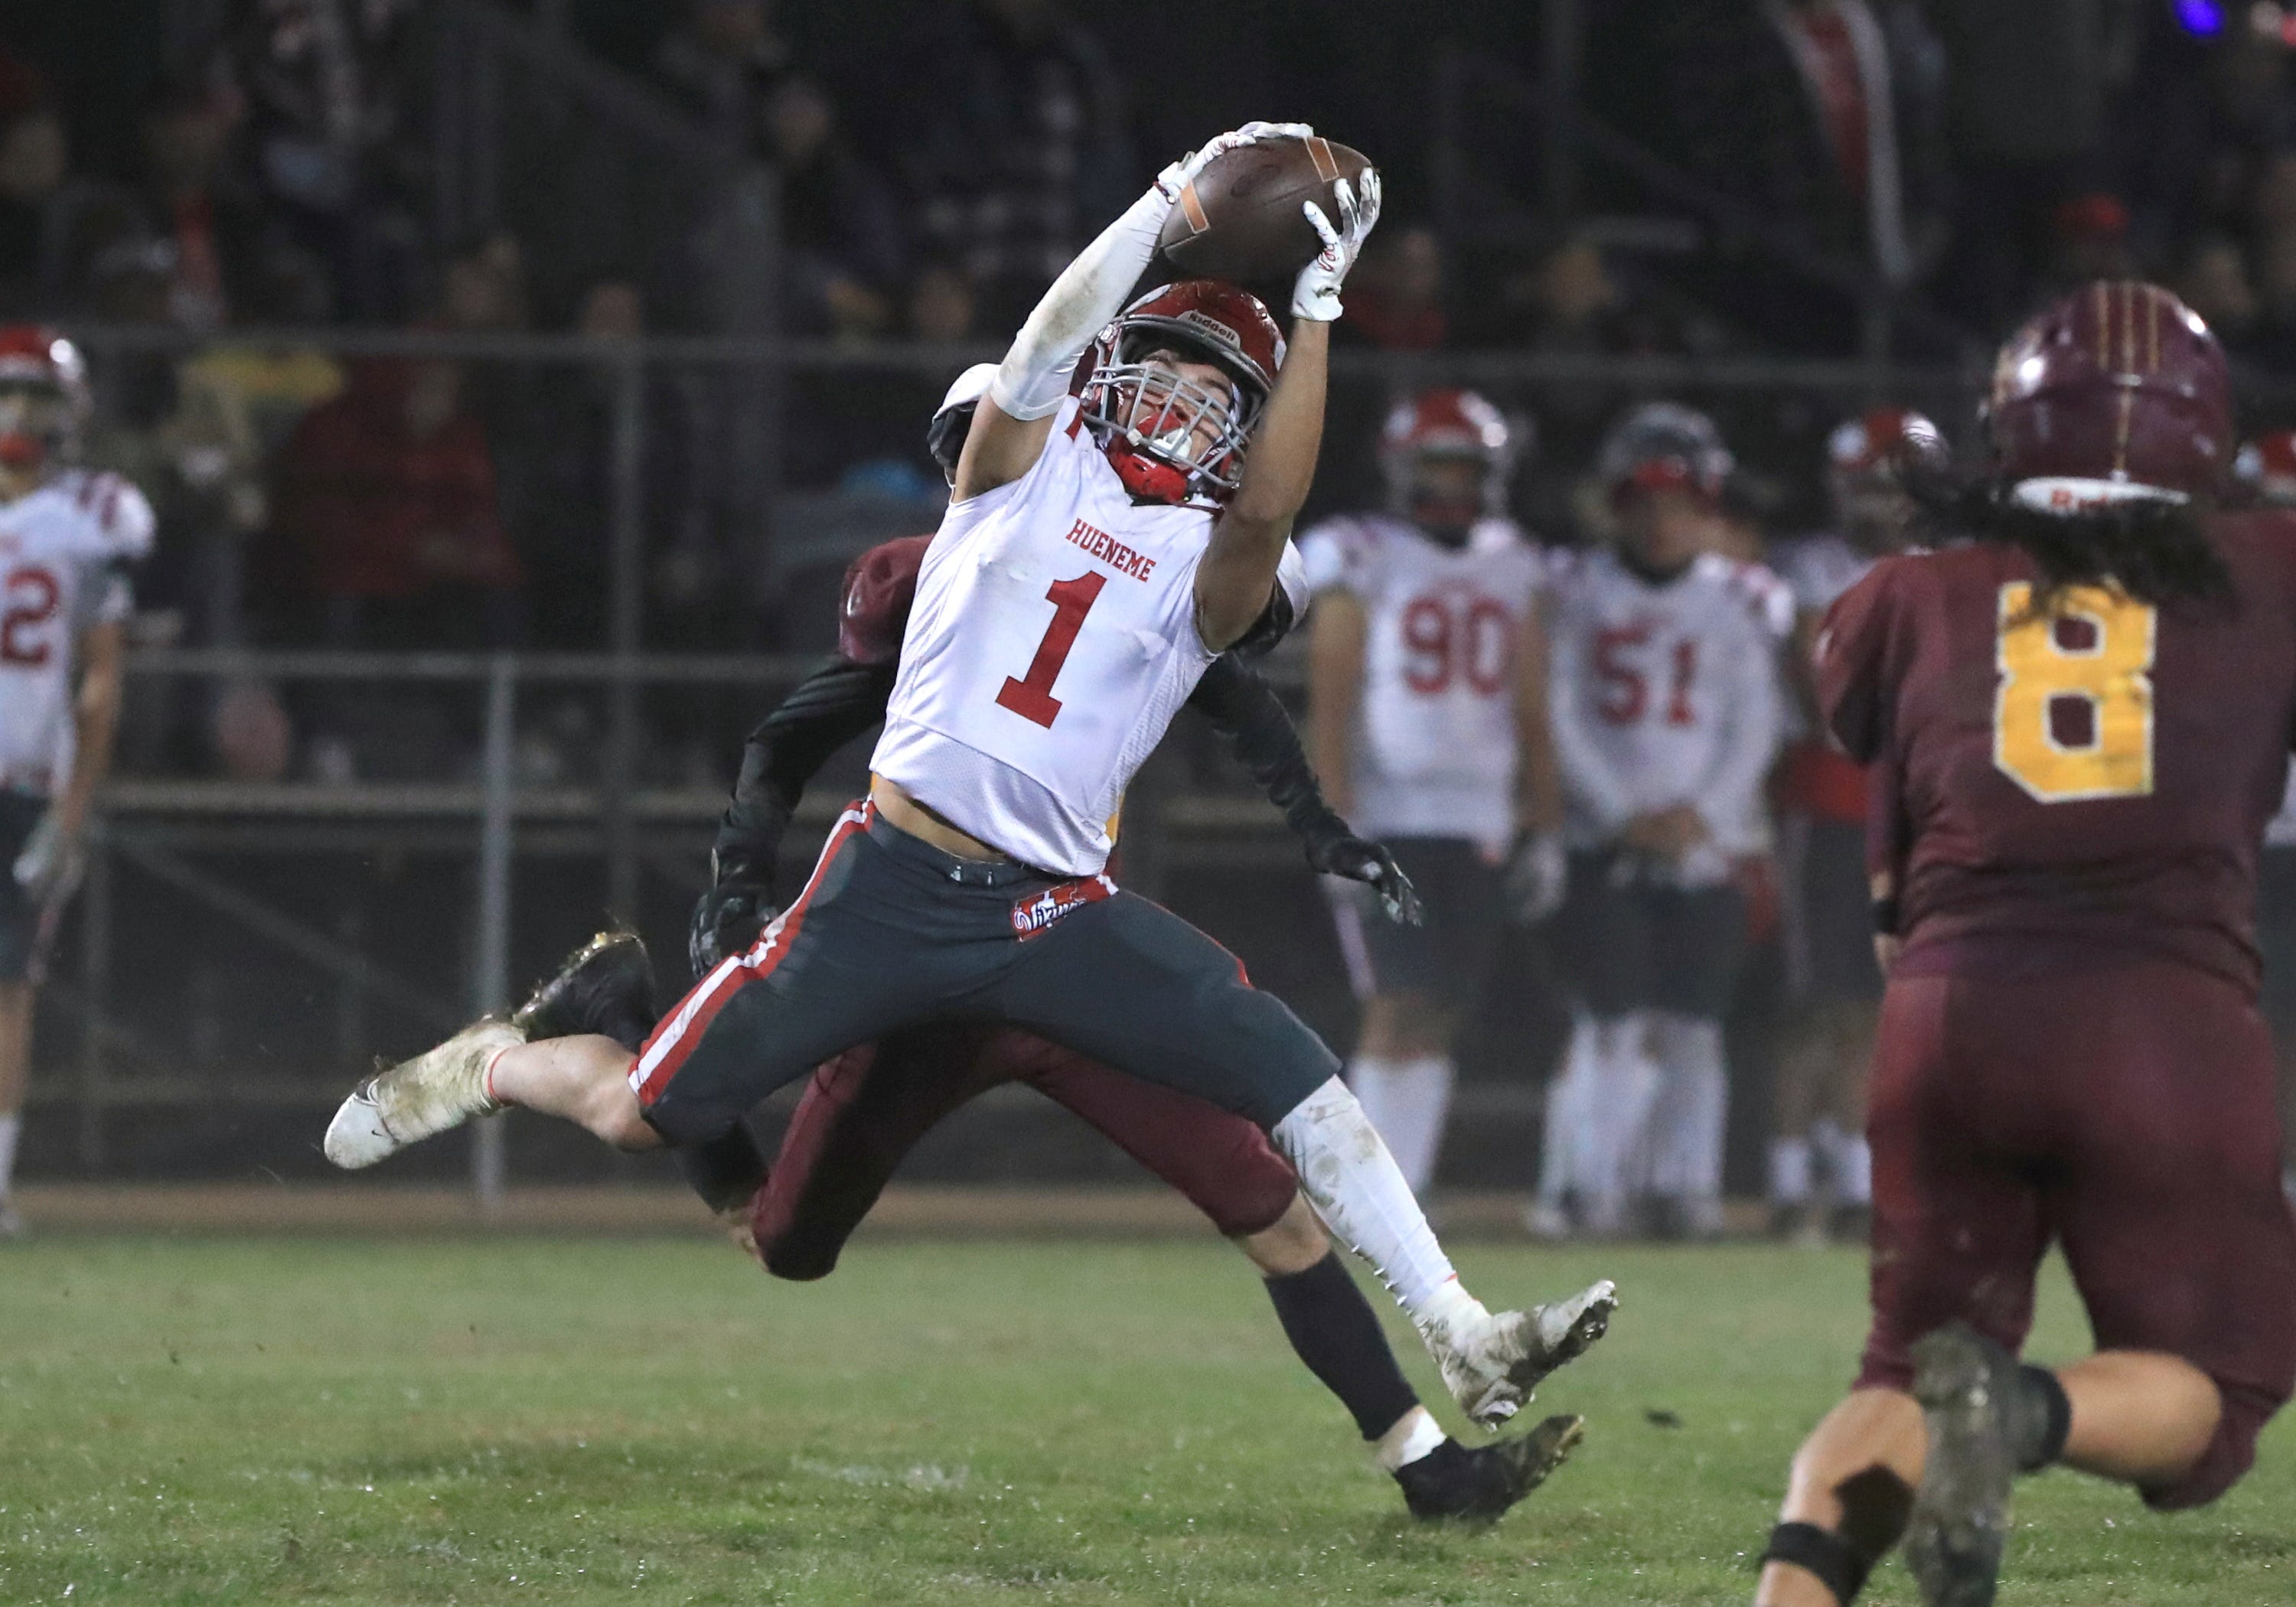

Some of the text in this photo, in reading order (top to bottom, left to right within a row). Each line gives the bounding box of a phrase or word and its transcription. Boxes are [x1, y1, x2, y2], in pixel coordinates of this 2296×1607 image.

[1065, 518, 1156, 582] HUENEME
[996, 570, 1107, 729] 1
[1399, 595, 1512, 699] 90
[1590, 618, 1699, 727] 51
[1994, 575, 2157, 804] 8
